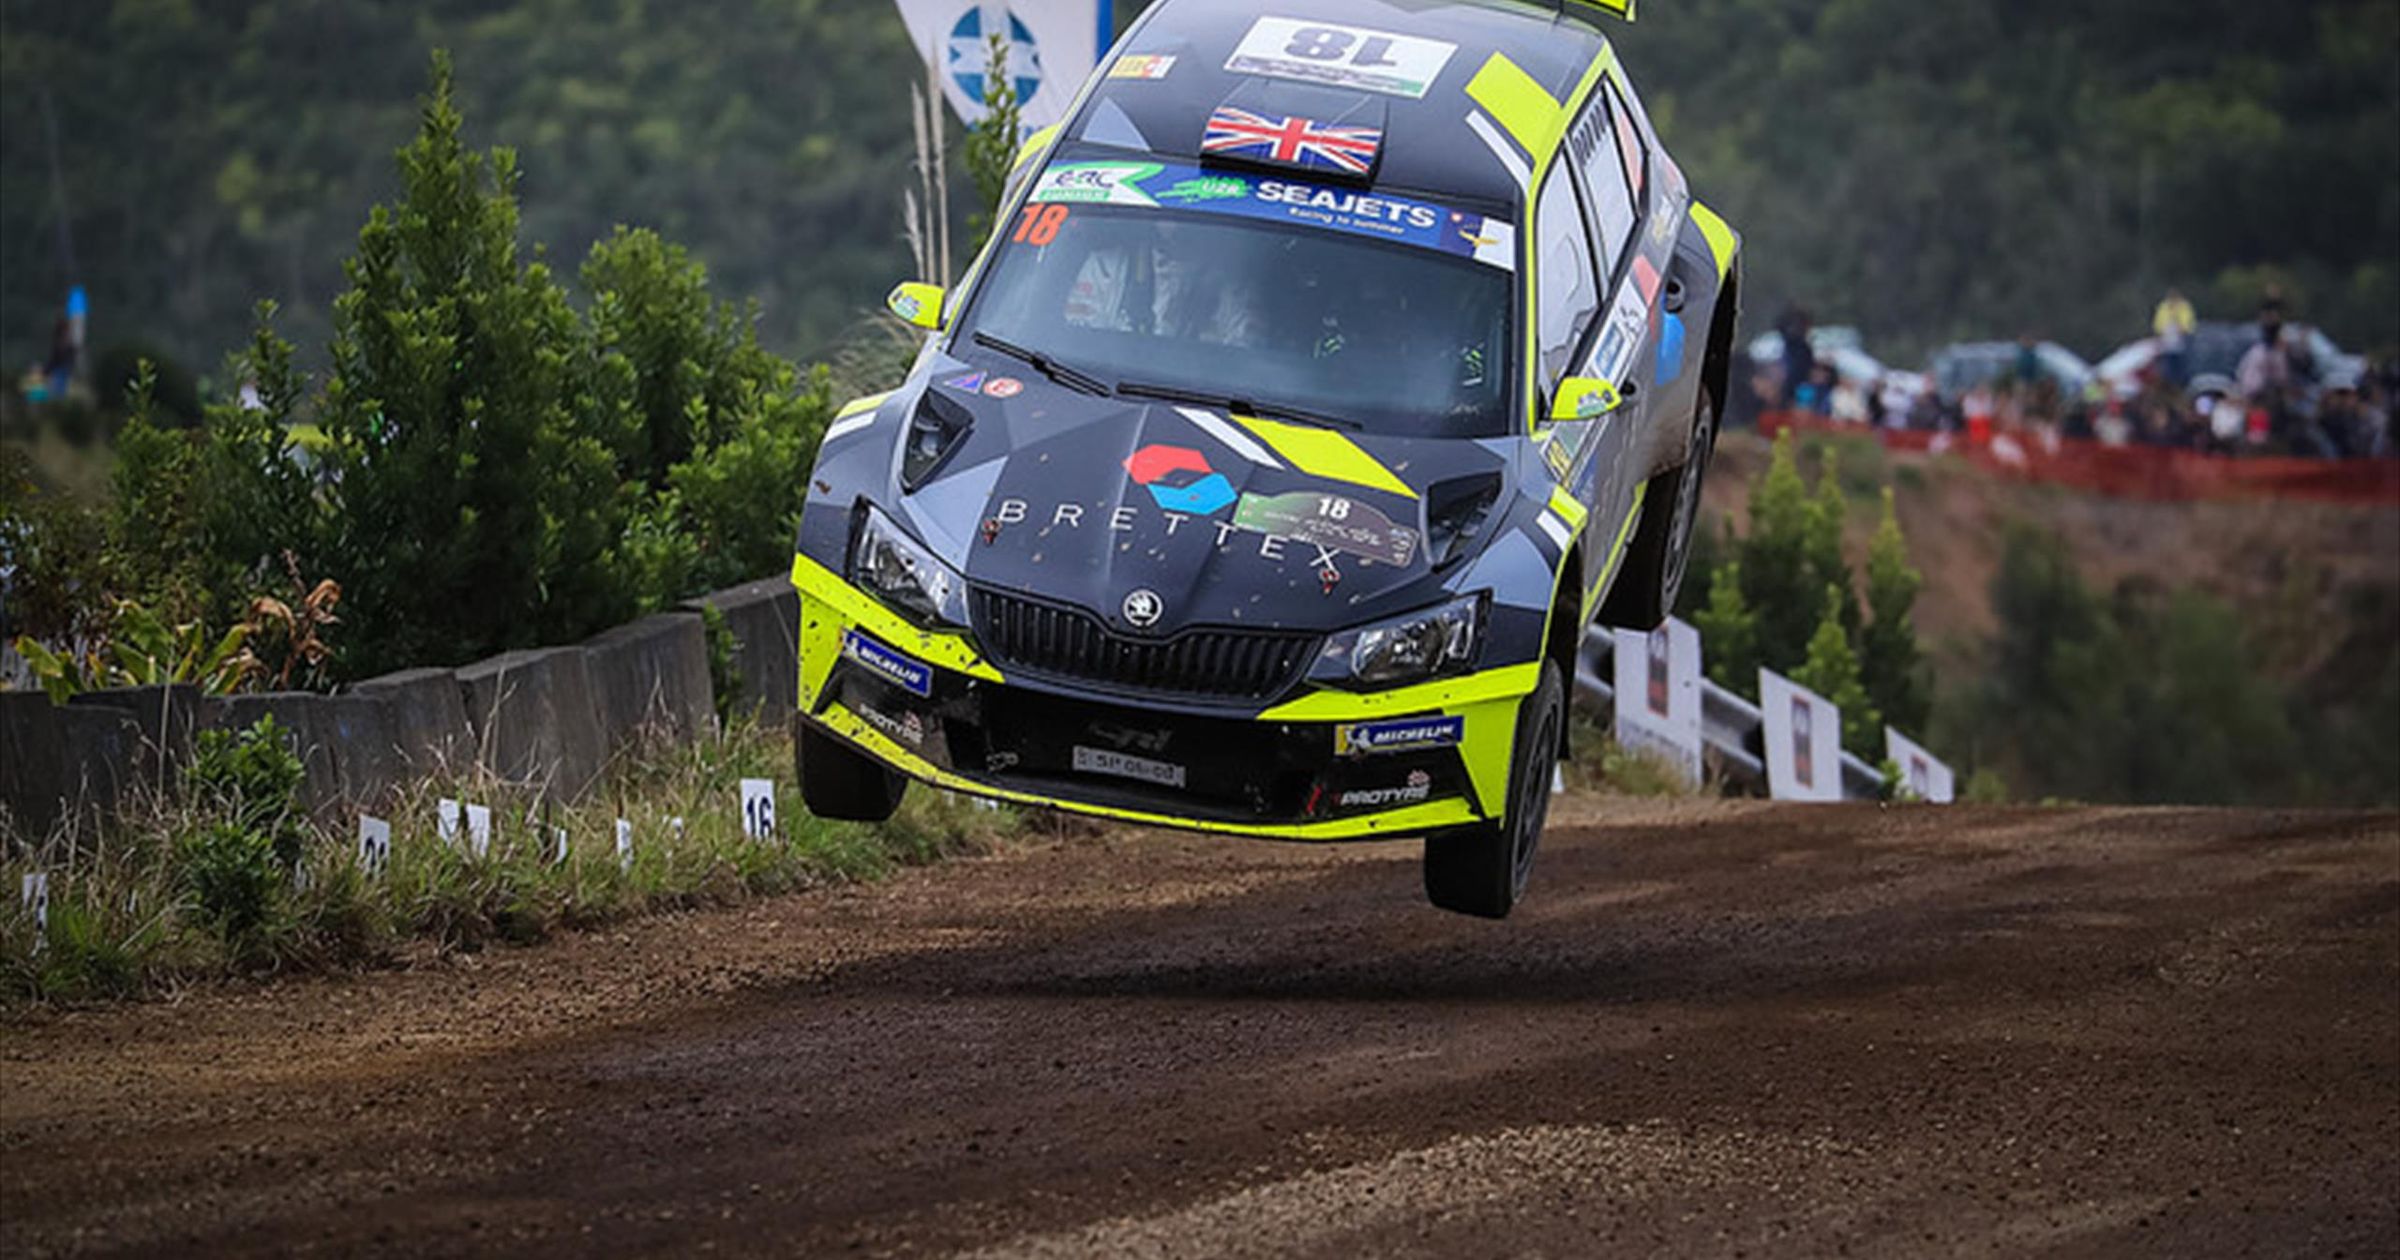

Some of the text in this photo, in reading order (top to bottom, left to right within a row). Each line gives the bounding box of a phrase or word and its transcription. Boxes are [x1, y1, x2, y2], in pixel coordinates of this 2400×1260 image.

[1284, 26, 1397, 68] 18
[1013, 203, 1069, 246] 18
[1256, 181, 1437, 228] SEAJETS
[1318, 497, 1350, 519] 18
[998, 499, 1342, 571] BRETTEX
[1373, 724, 1456, 743] MICHELIN
[746, 796, 774, 841] 16
